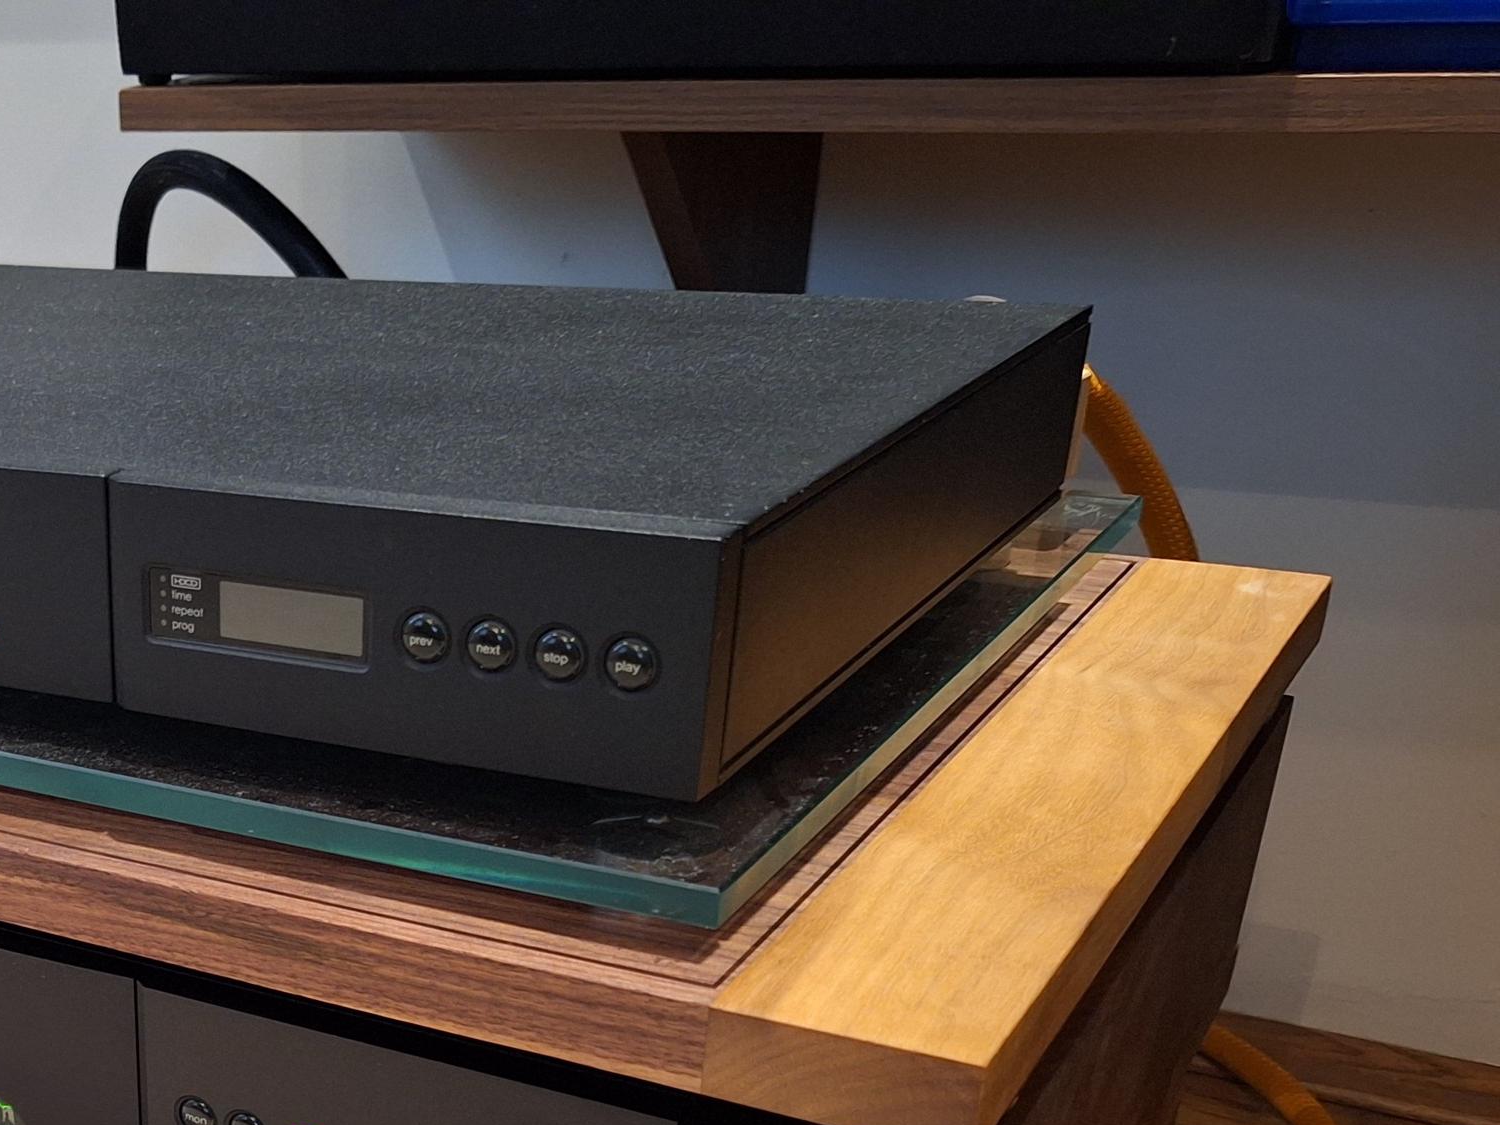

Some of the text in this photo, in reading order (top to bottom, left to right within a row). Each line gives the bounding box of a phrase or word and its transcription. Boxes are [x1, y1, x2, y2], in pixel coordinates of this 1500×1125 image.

[171, 589, 192, 601] time
[171, 605, 204, 617] repeat
[171, 621, 195, 633] prog
[409, 635, 433, 647] prev
[476, 644, 501, 656] next
[543, 652, 569, 666] stop
[615, 661, 641, 676] play
[185, 1113, 208, 1125] mon
